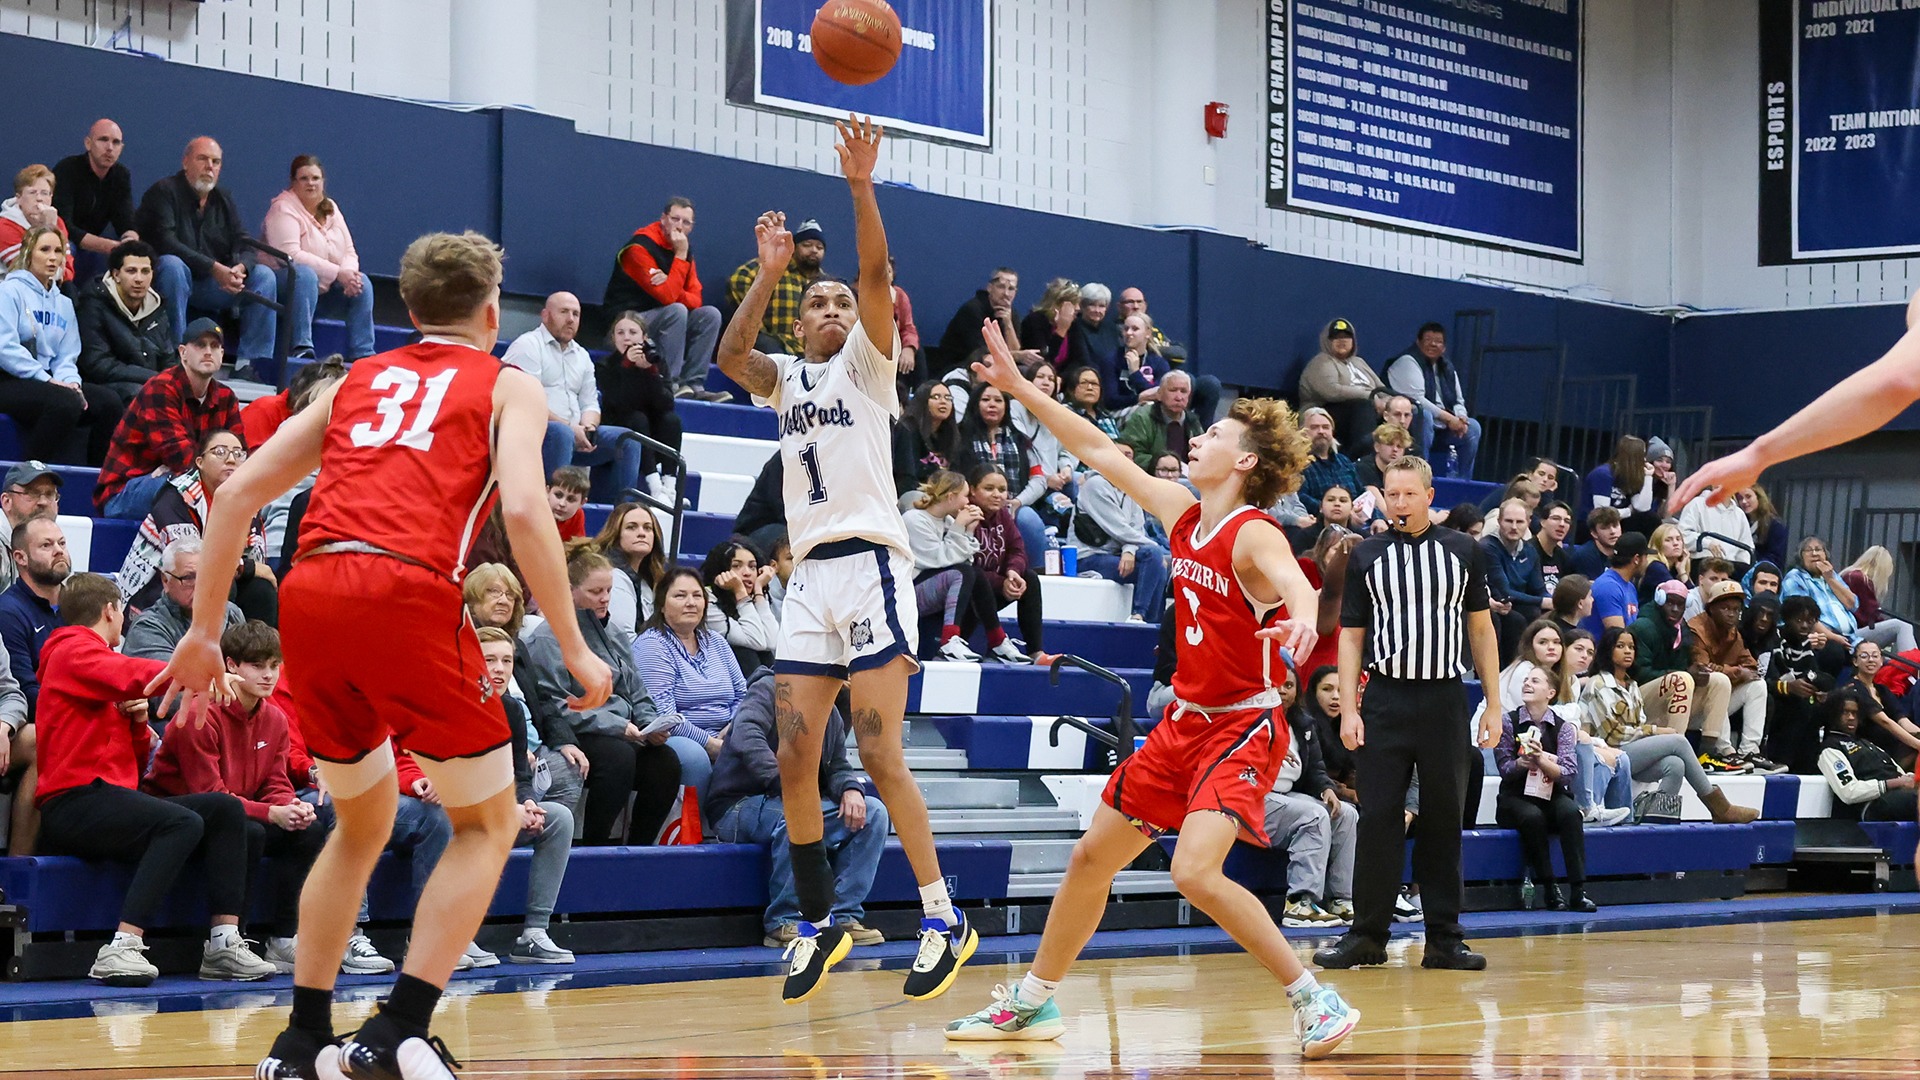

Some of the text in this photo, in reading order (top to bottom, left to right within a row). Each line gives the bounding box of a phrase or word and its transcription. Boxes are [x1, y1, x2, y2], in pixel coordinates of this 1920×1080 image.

[766, 26, 812, 53] 2018 20
[1805, 19, 1875, 39] 2020 2021
[1270, 112, 1285, 190] WJCAA
[1767, 81, 1785, 171] ESPORTS
[1805, 133, 1876, 152] 2022 2023
[1830, 113, 1867, 131] TEAM
[350, 365, 459, 452] 31
[798, 441, 828, 506] 1
[1182, 586, 1204, 646] 3
